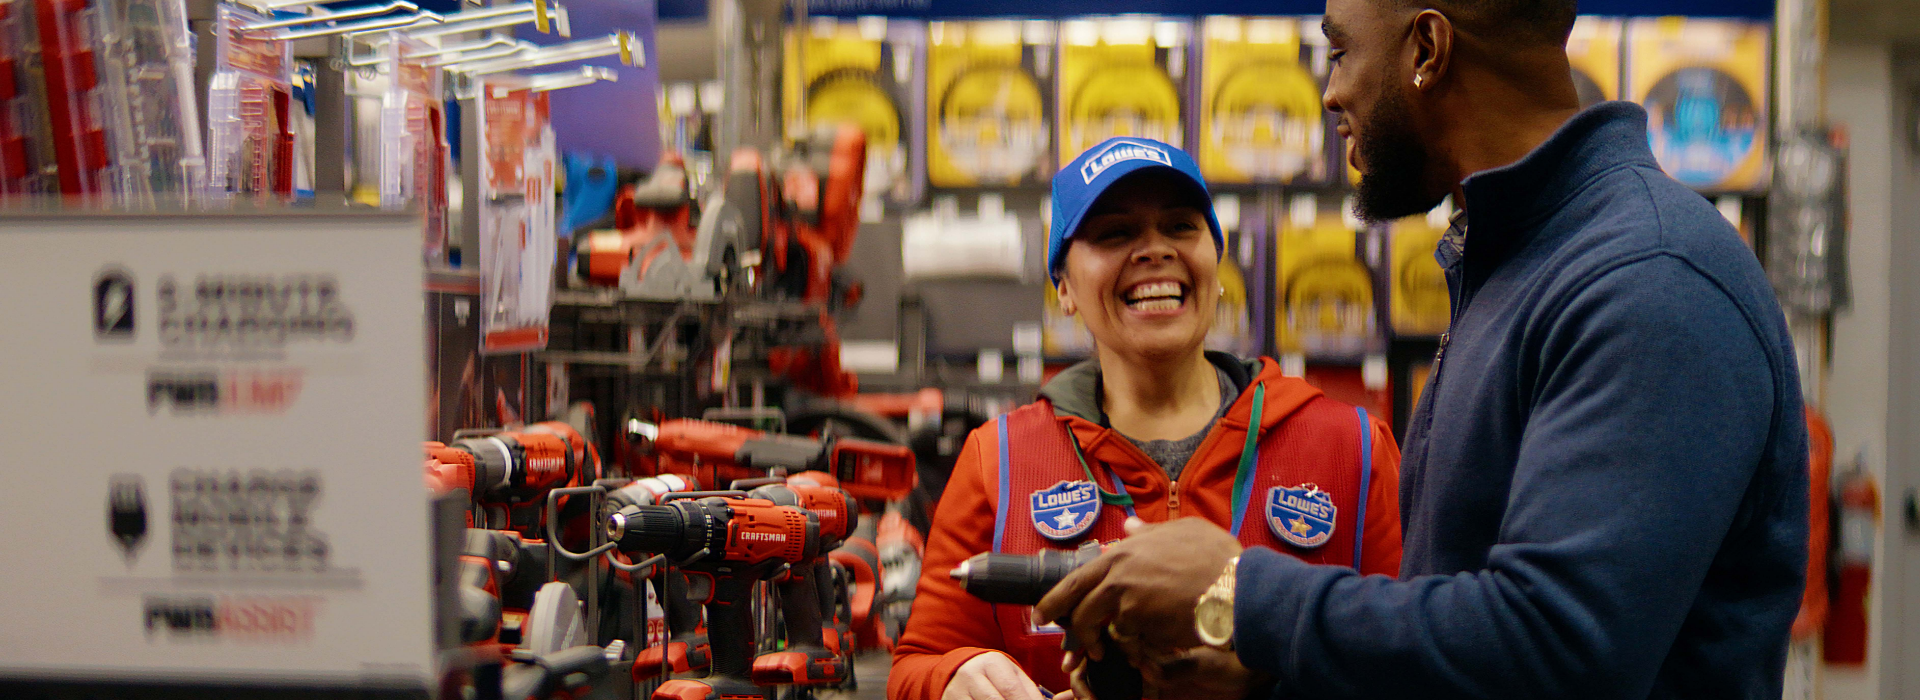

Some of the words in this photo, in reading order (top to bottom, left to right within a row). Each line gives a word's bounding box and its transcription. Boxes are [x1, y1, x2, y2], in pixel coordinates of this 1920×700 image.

[1090, 146, 1160, 174] LOWE'S
[1038, 486, 1093, 508] LOWE'S
[1278, 490, 1329, 518] LOWE'S
[741, 531, 786, 542] CRAFTSMAN
